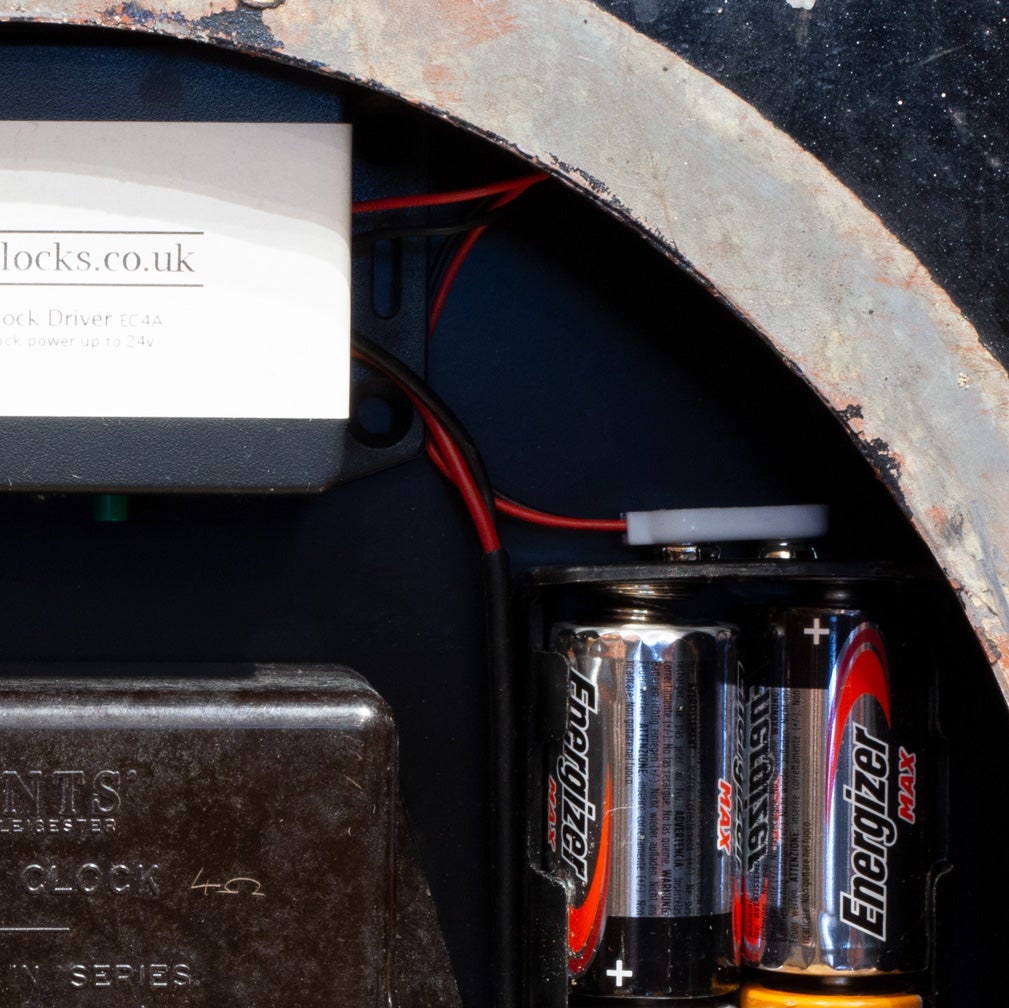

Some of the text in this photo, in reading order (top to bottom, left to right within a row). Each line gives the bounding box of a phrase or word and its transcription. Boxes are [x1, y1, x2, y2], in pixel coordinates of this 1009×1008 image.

[28, 336, 74, 351] power
[80, 337, 100, 351] up
[106, 335, 121, 348] to
[48, 308, 112, 328] Driver
[557, 666, 599, 883] Energizer
[897, 745, 917, 824] MAX
[717, 778, 733, 857] MAX
[839, 720, 898, 942] Energizer
[20, 862, 161, 896] CLOCK
[70, 961, 192, 988] SERIES
